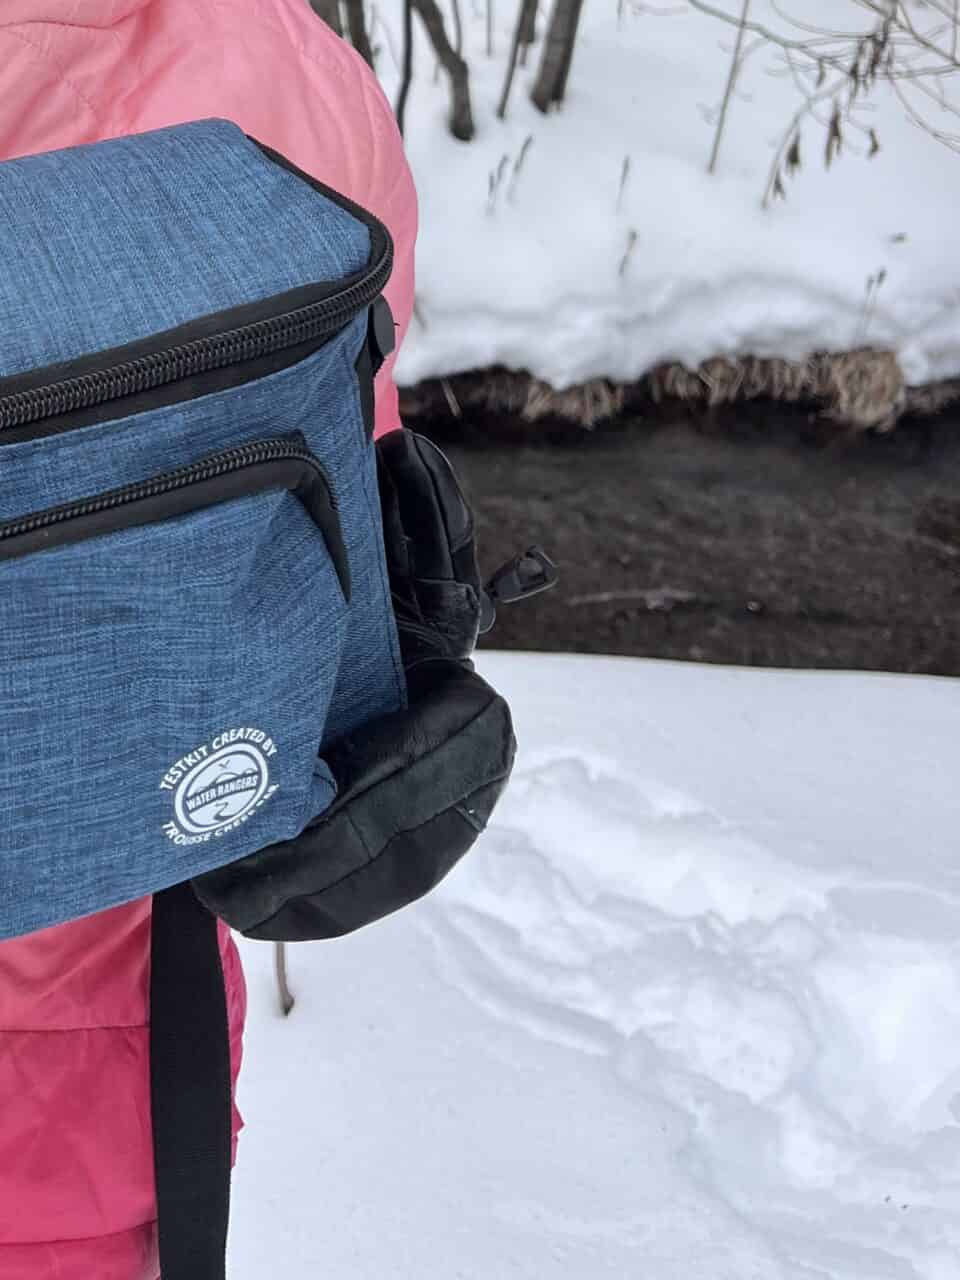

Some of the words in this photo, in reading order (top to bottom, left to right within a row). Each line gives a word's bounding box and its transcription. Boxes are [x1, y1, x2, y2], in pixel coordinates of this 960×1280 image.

[160, 745, 209, 790] TESTKIT
[212, 727, 266, 750] CREATED
[261, 737, 278, 757] BY
[186, 786, 217, 810] WATER
[217, 775, 258, 795] RANGERS
